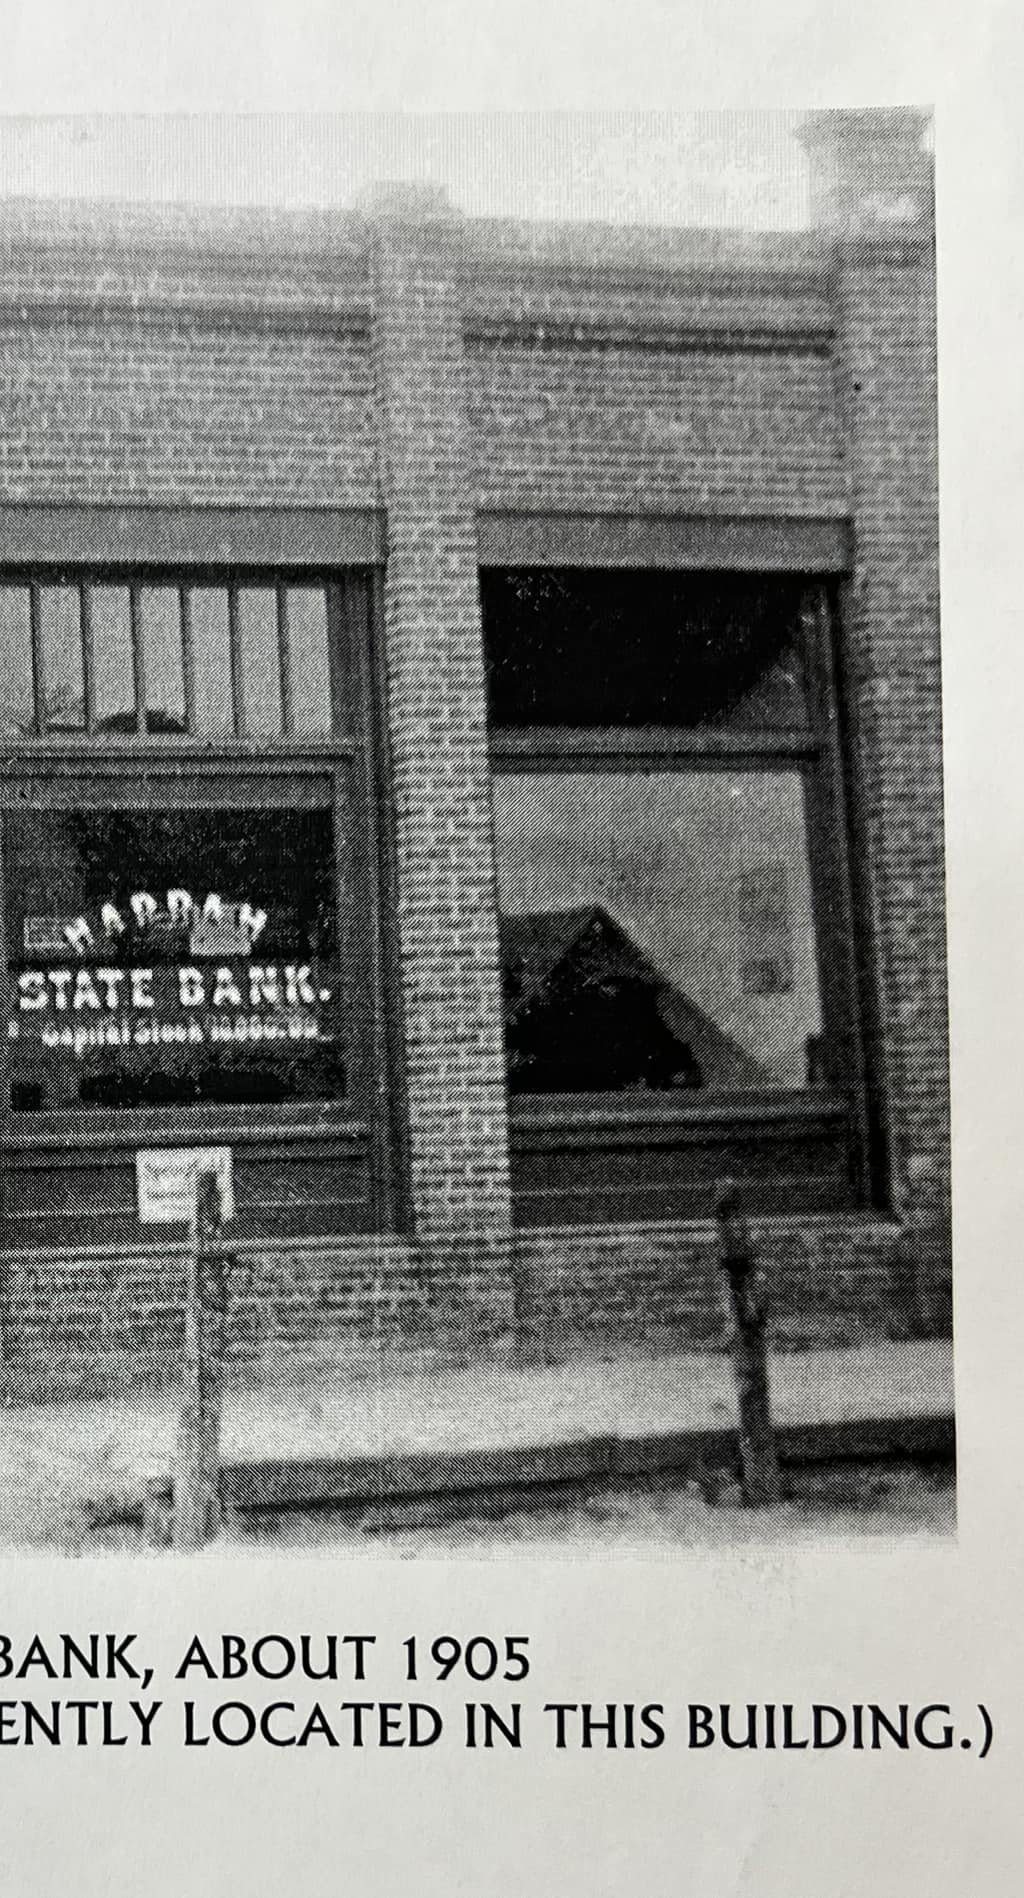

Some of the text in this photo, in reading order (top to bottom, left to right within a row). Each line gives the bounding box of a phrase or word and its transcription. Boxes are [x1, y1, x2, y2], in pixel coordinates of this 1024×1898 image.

[18, 968, 155, 1009] STATE
[178, 964, 332, 1006] BANK.
[174, 1634, 377, 1680] ABOUT
[402, 1636, 530, 1682] 1905
[184, 1701, 443, 1747] LOCATED
[465, 1703, 522, 1748] IN
[543, 1703, 665, 1749] THIS
[687, 1704, 994, 1759] BUILDING.)
